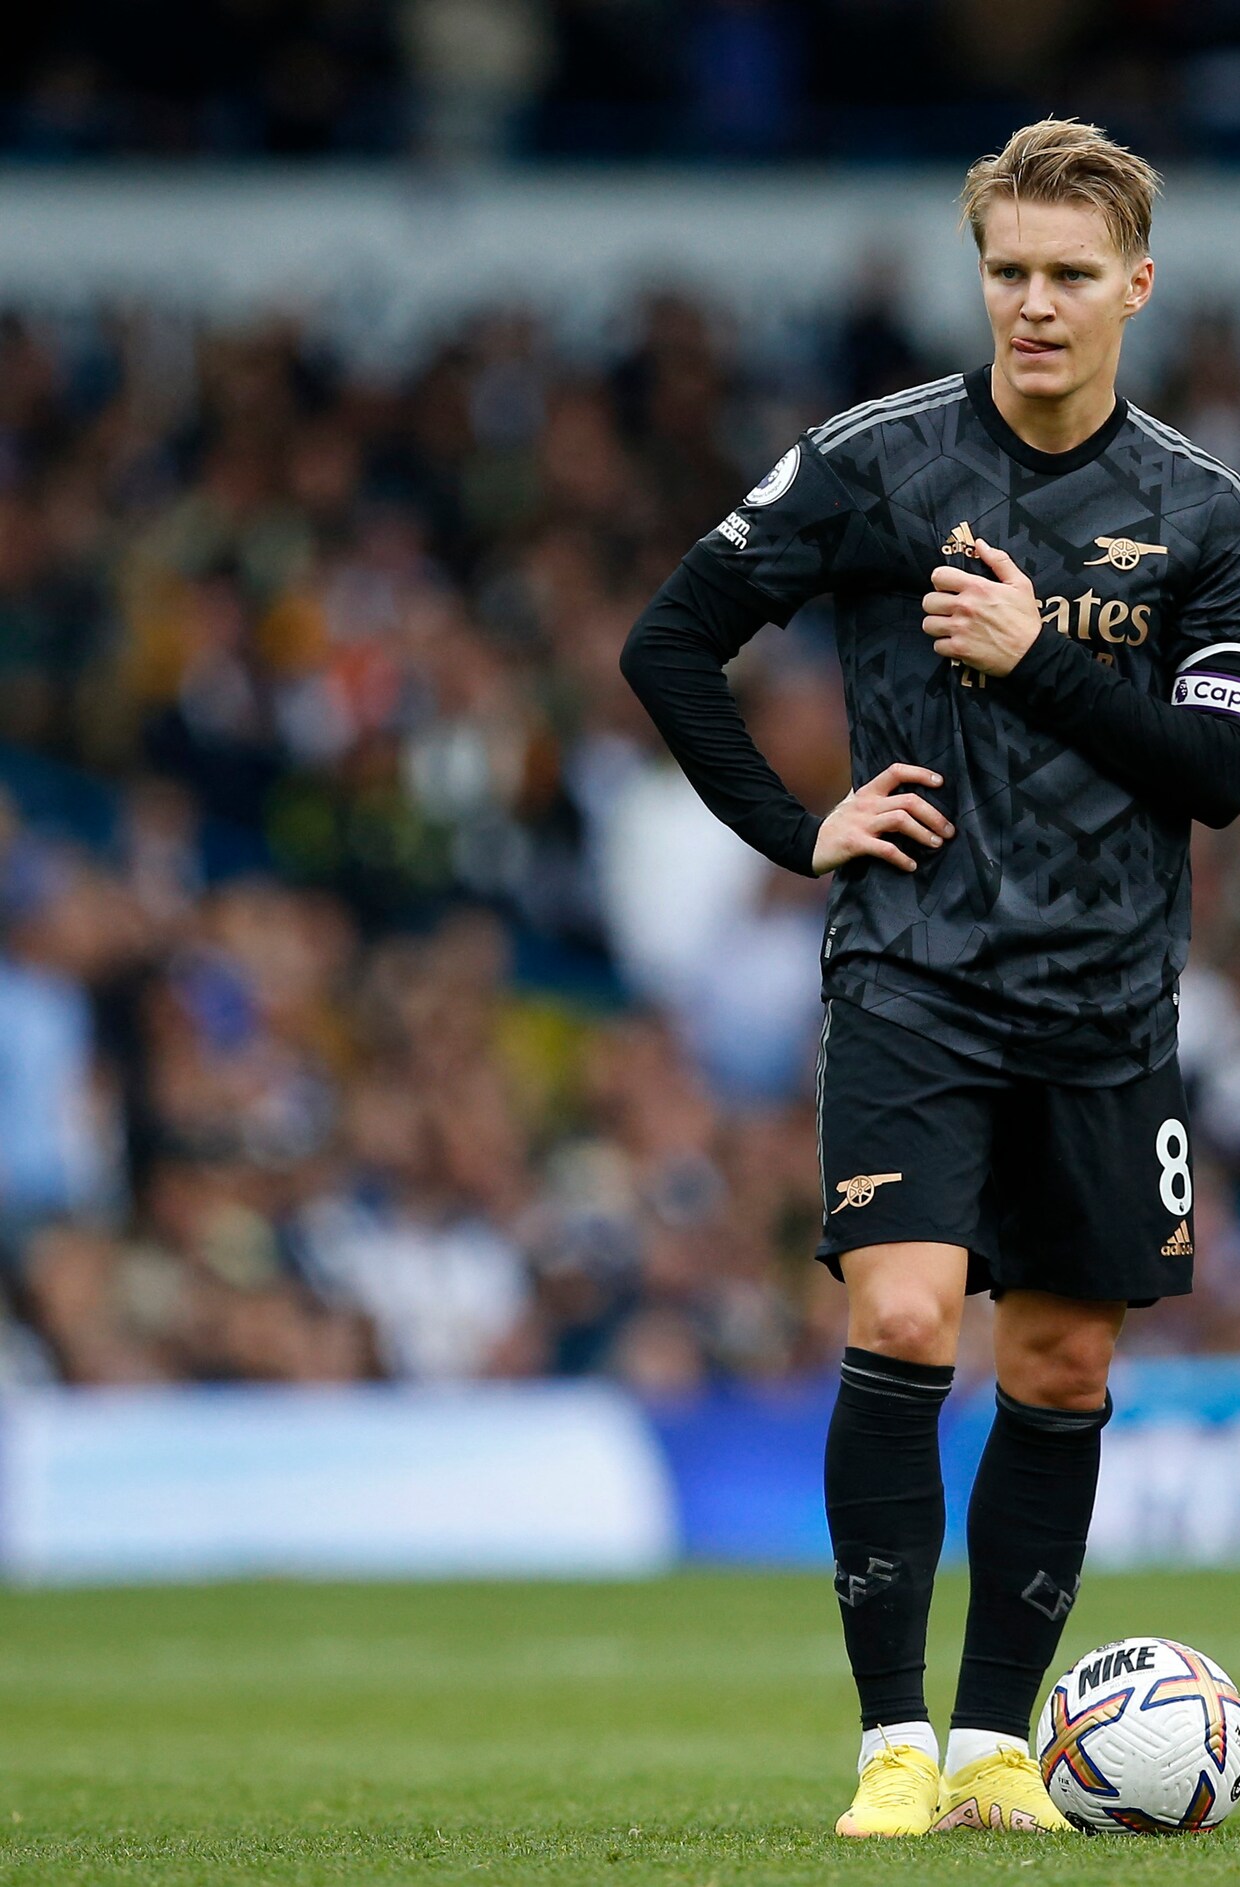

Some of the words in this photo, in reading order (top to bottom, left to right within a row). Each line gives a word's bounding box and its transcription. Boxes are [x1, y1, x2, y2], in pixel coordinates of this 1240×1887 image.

[726, 511, 751, 536] oom
[1036, 588, 1151, 646] ates
[1155, 1118, 1192, 1216] 8
[1079, 1646, 1158, 1700] NIKE
